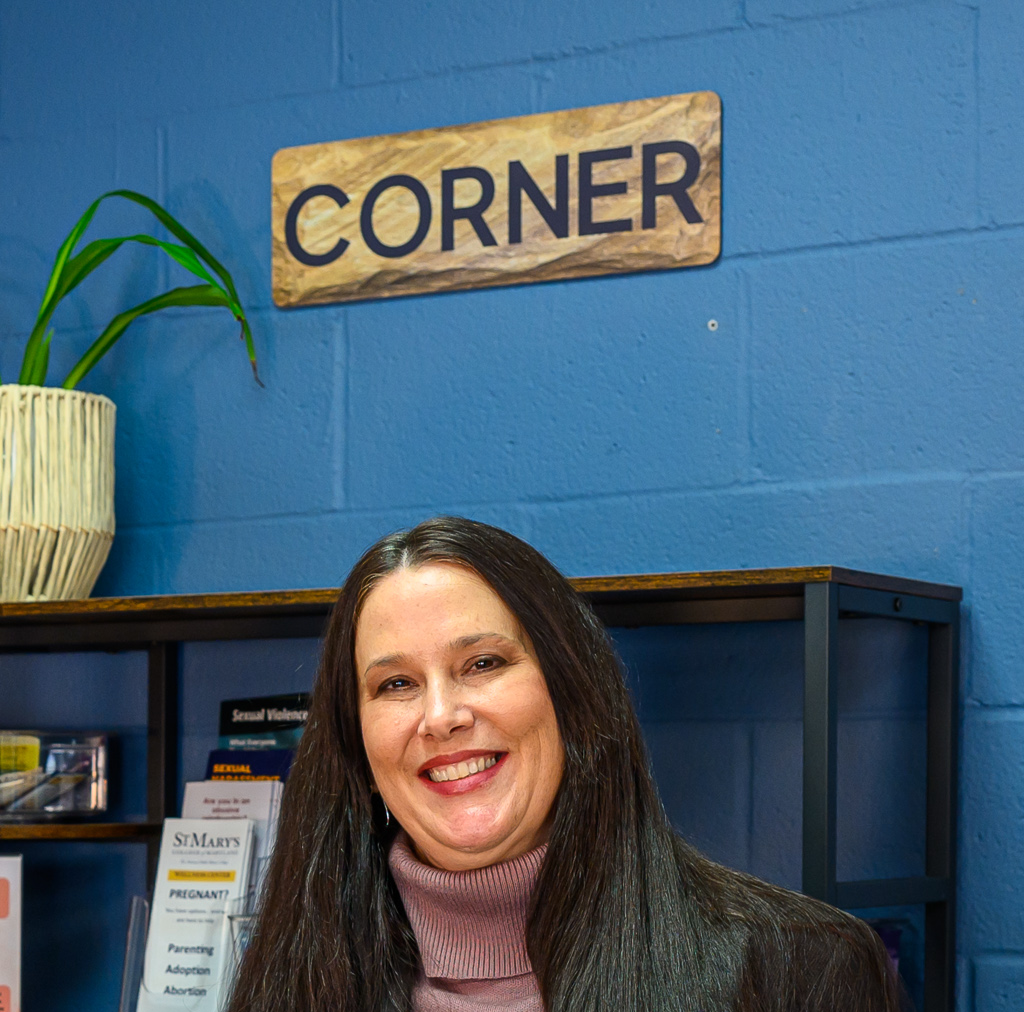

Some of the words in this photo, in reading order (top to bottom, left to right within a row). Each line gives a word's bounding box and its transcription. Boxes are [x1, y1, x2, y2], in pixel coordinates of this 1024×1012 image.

[285, 140, 704, 267] CORNER
[233, 709, 265, 722] Sexual
[267, 707, 308, 721] Violence
[213, 764, 251, 773] SEXUAL
[169, 889, 230, 900] PREGNANT?
[167, 943, 214, 957] Parenting
[165, 964, 211, 976] Adoption
[163, 985, 207, 996] Abortion
